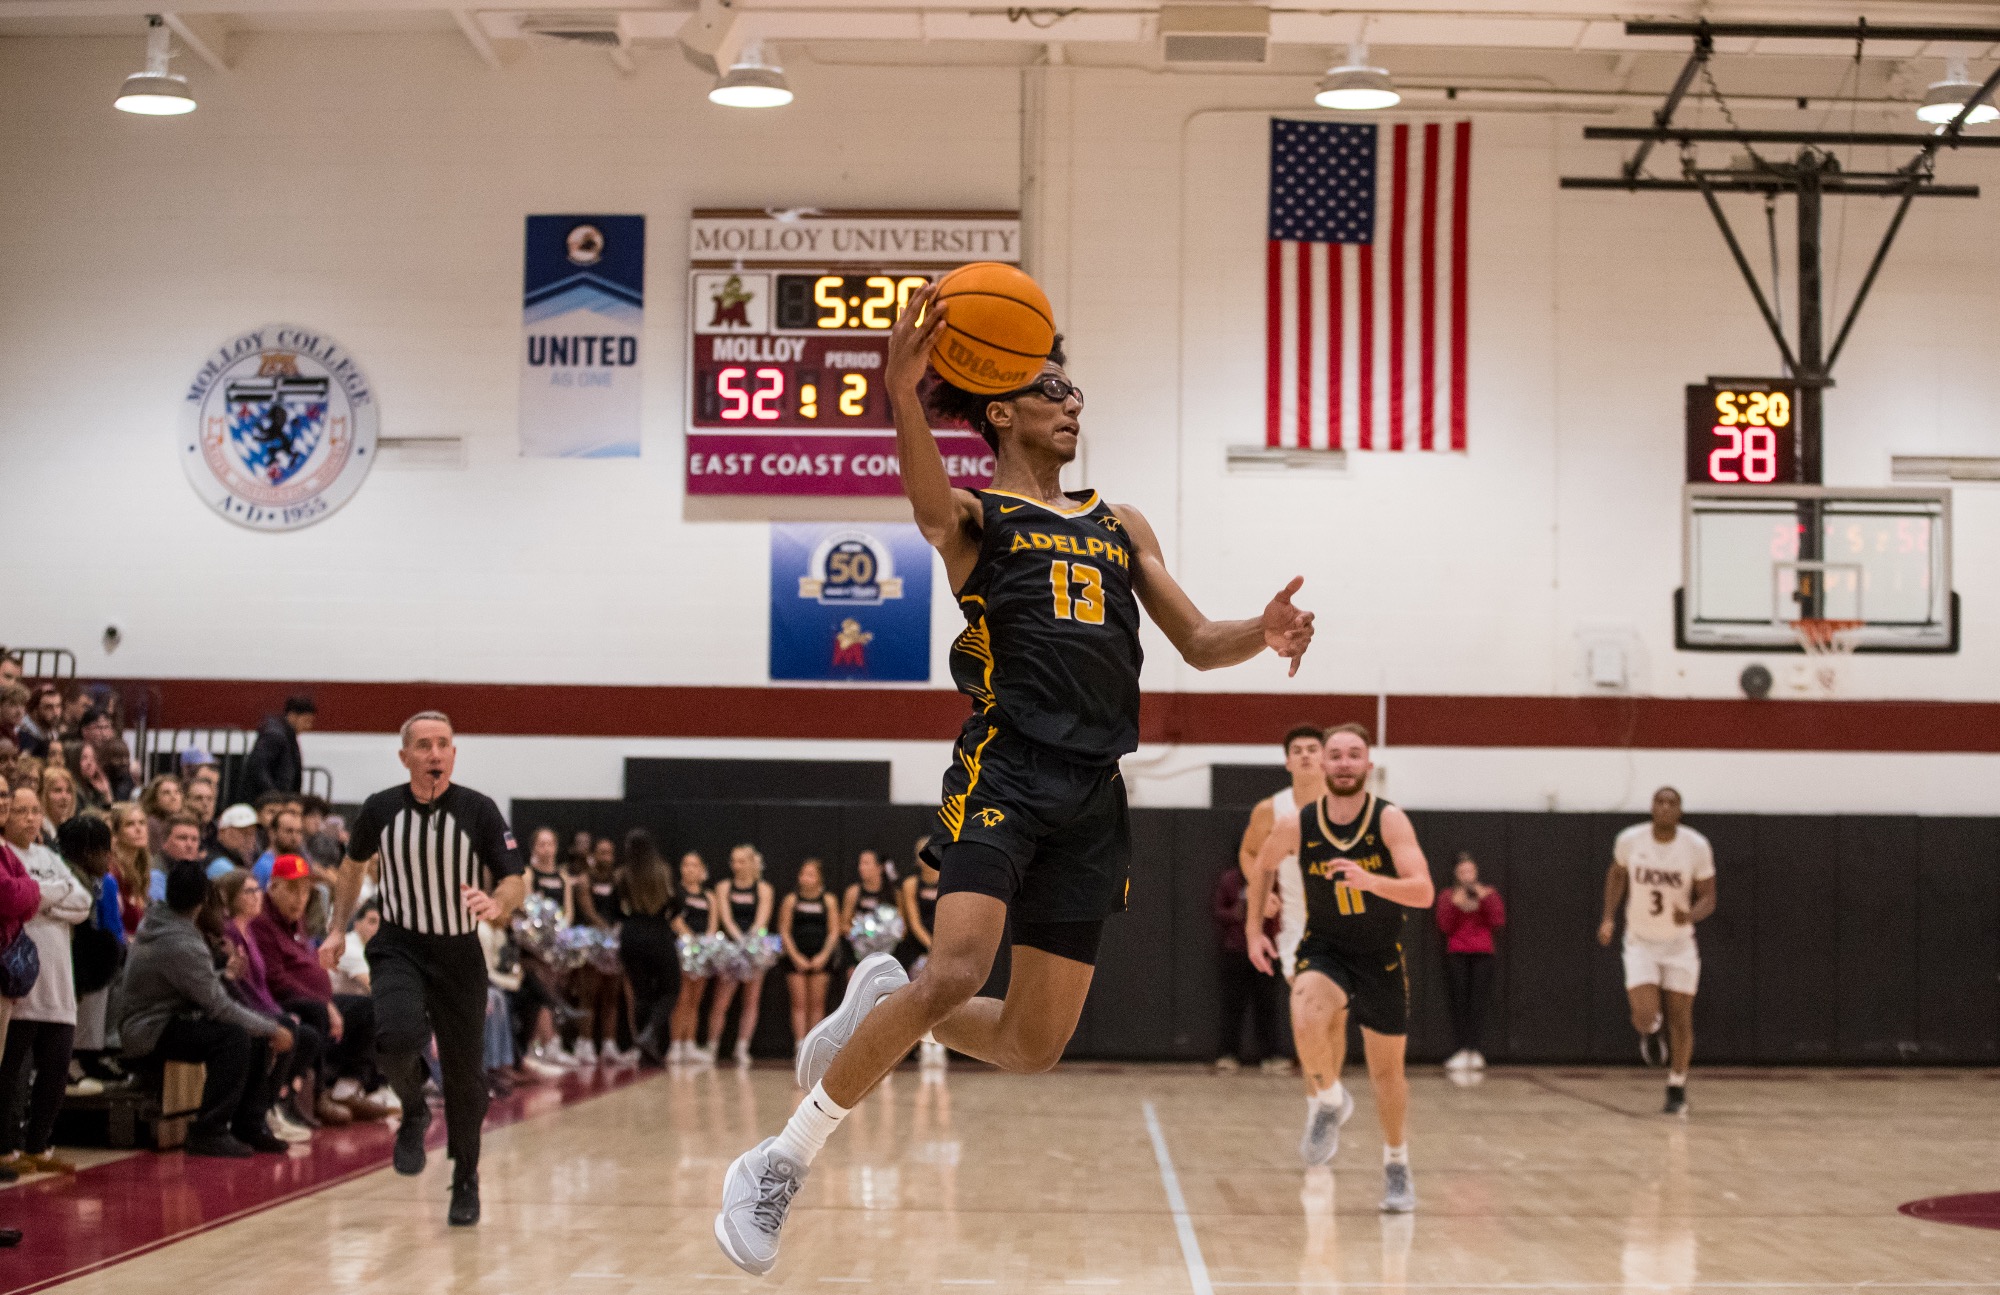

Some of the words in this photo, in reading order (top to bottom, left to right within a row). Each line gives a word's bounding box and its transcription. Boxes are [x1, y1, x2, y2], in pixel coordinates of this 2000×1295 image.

[695, 228, 821, 251] MOLLOY
[832, 228, 1016, 252] UNIVERSITY
[186, 331, 263, 405] MOLLOY
[277, 330, 371, 406] COLLEGE
[527, 335, 638, 367] UNITED
[712, 337, 807, 363] MOLLOY
[824, 351, 882, 369] PERIOD
[947, 337, 1028, 383] Wilson
[718, 367, 785, 420] 52
[839, 373, 868, 416] 2
[1715, 391, 1791, 427] 5:20
[689, 452, 756, 476] EAST
[760, 453, 846, 476] COAST
[1708, 425, 1776, 483] 28
[829, 552, 874, 584] 50
[1050, 560, 1105, 626] 13
[1335, 880, 1367, 916] 11
[1649, 890, 1664, 917] 3
